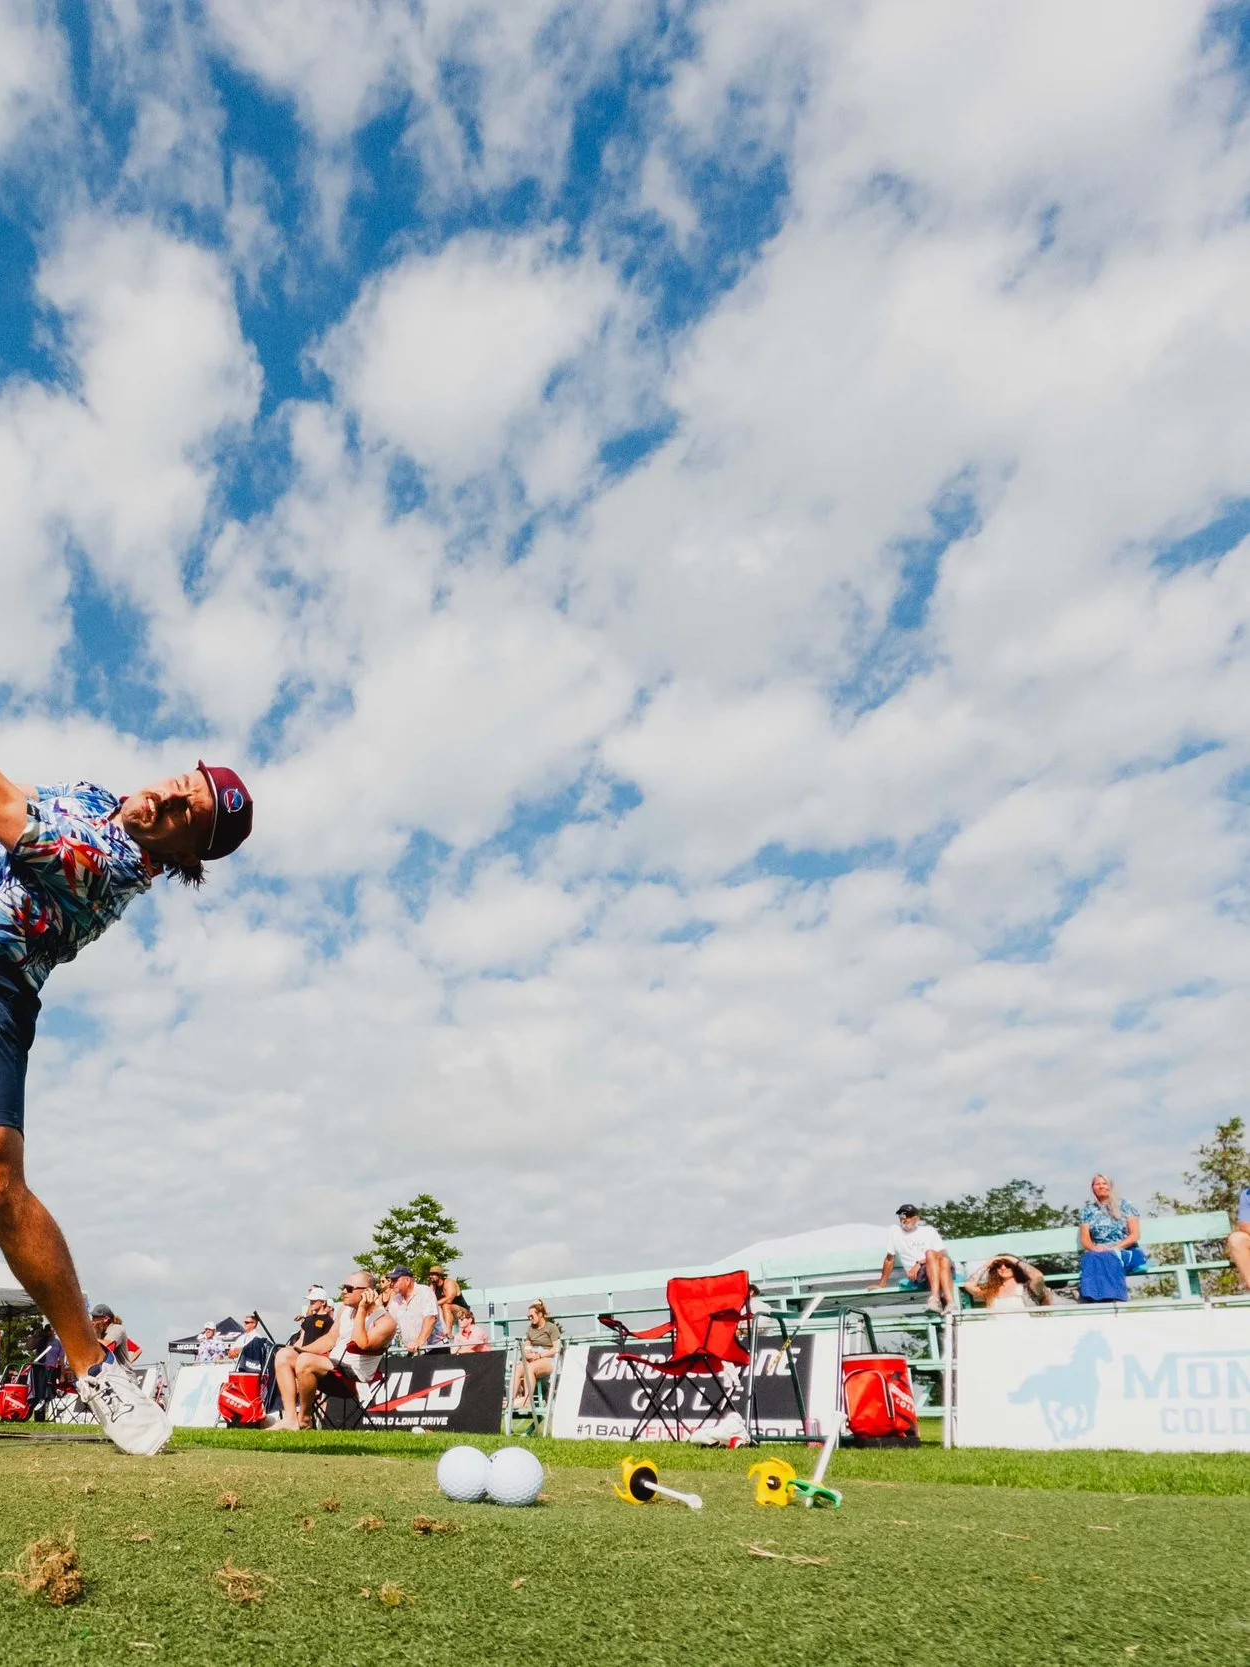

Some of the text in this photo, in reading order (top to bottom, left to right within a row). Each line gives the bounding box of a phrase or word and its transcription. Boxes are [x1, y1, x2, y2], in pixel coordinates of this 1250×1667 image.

[631, 1386, 744, 1411] GOLF
[362, 1416, 449, 1426] WORLD LONG DRIVE
[577, 1425, 592, 1436] #1
